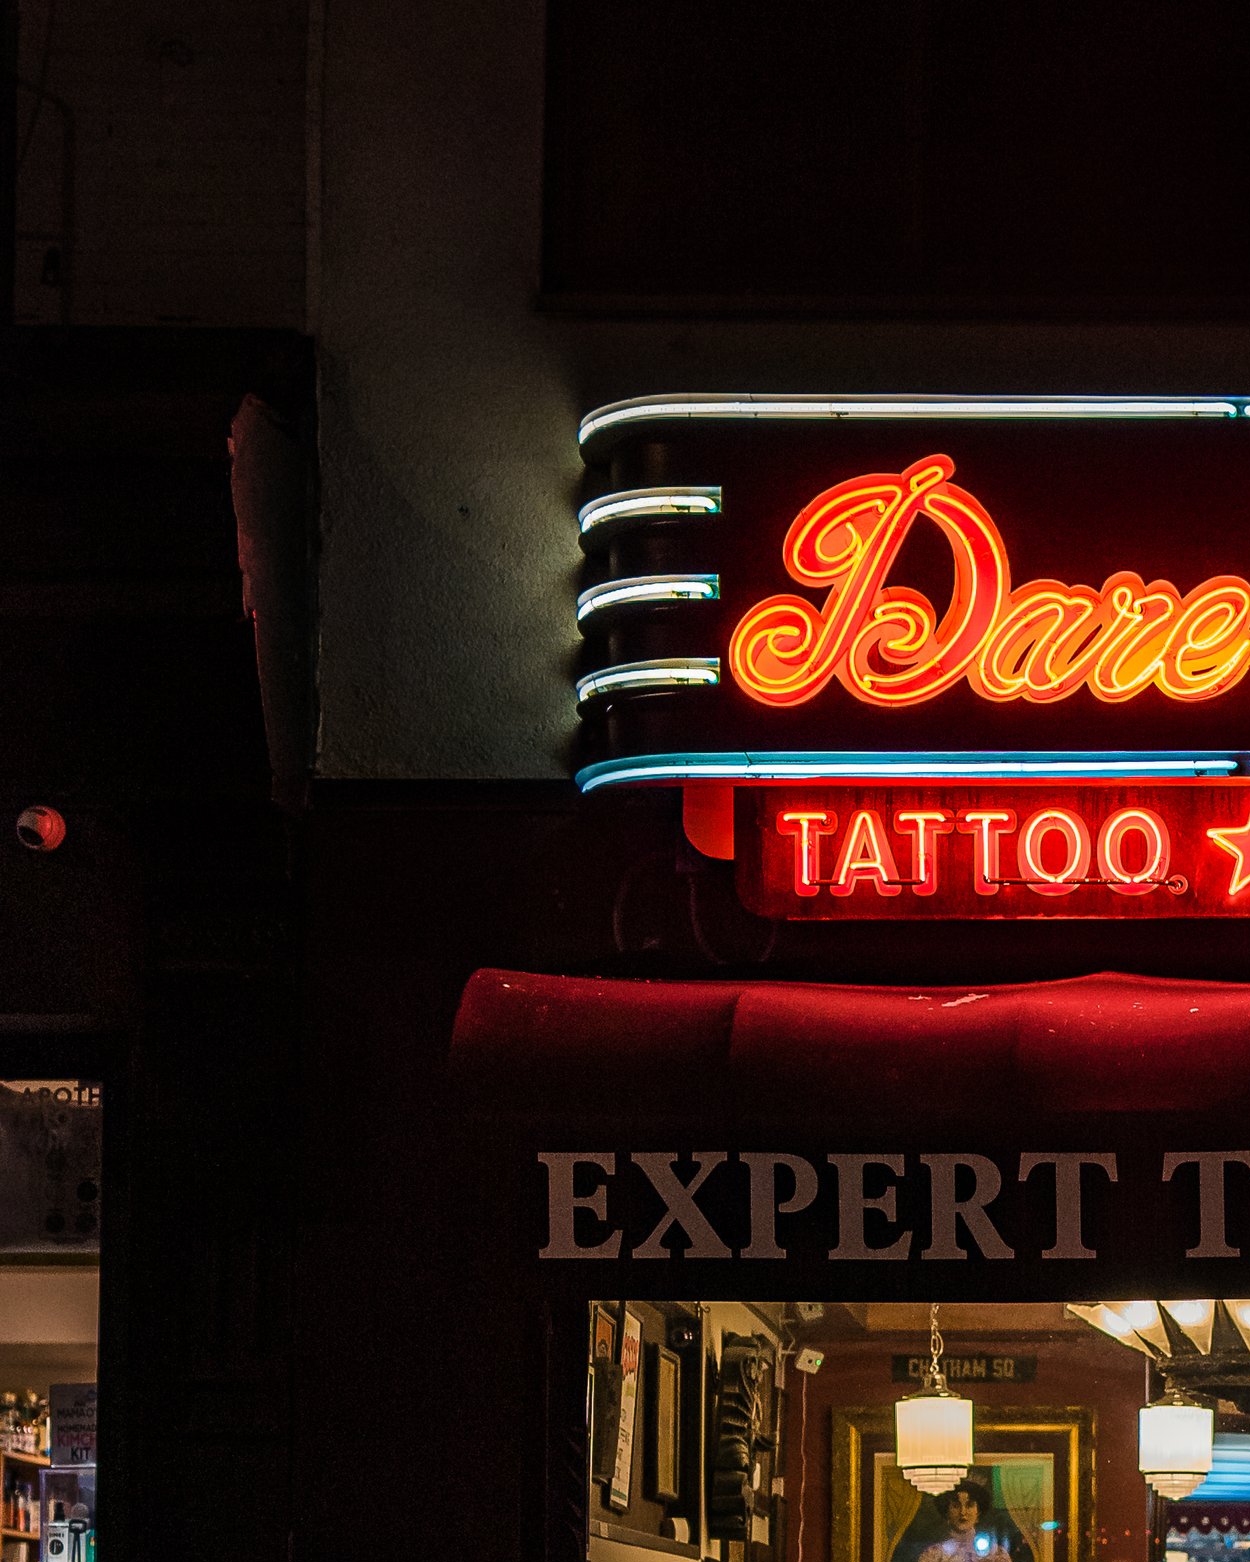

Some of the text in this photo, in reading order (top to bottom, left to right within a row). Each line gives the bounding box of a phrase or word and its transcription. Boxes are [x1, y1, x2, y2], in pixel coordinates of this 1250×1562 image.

[776, 807, 1172, 897] TATTOO
[536, 1150, 1119, 1261] EXPERT
[908, 1358, 986, 1377] CHTHAM
[71, 1446, 90, 1460] KIT
